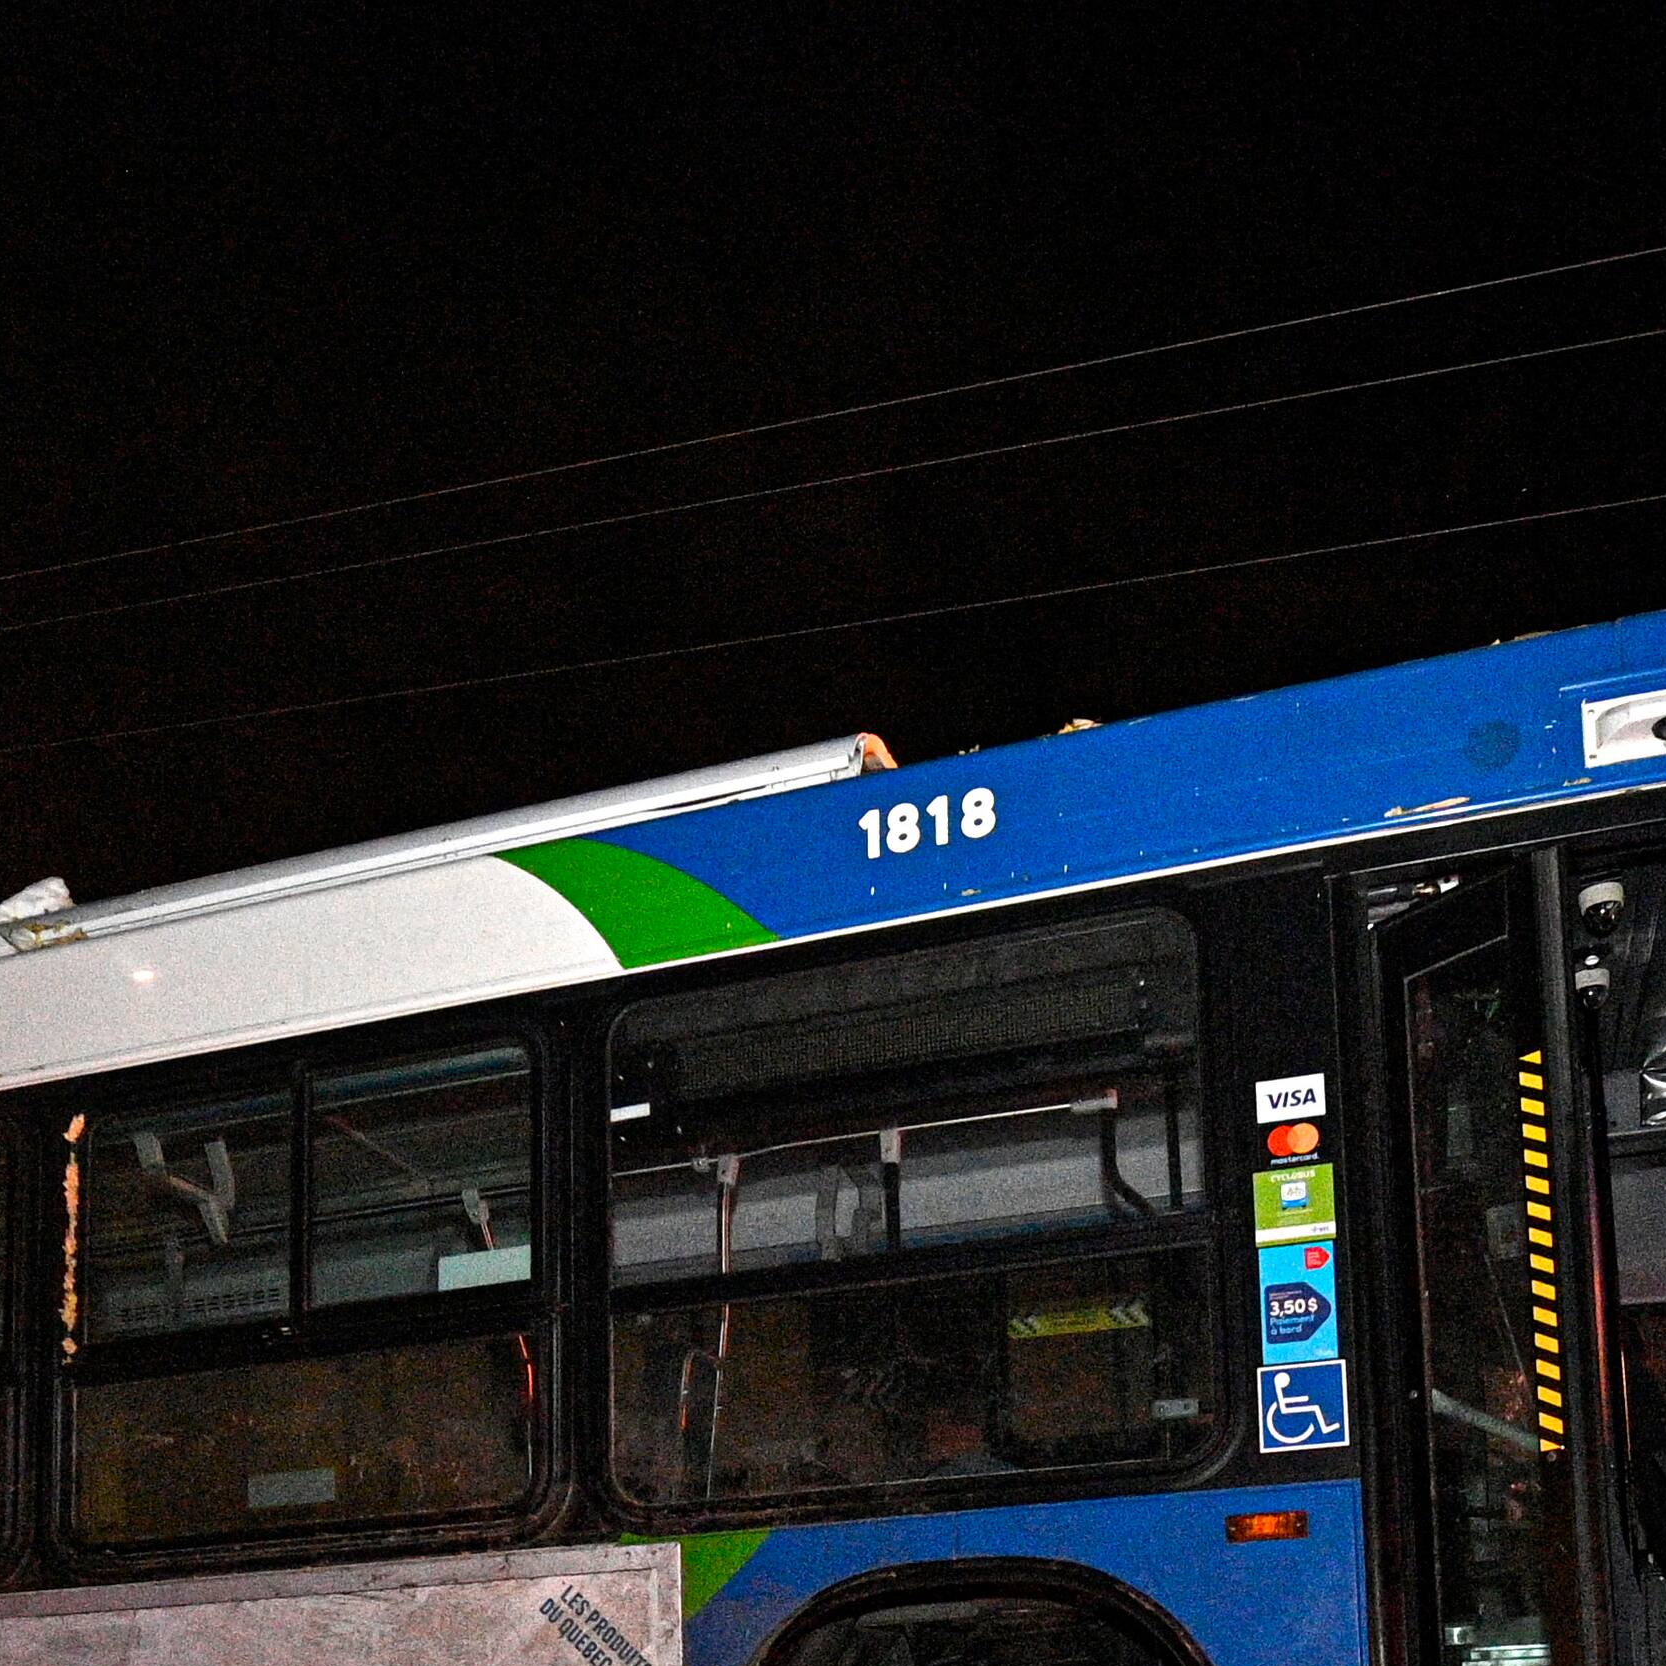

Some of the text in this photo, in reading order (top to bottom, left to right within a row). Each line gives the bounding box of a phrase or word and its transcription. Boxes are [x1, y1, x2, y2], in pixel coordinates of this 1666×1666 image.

[858, 787, 997, 860] 1818
[1266, 1088, 1317, 1110] VISA
[1270, 1169, 1316, 1183] CYCLOBUS
[1269, 1297, 1319, 1317] 3,50 $
[1279, 1323, 1303, 1335] bord
[539, 1598, 564, 1623] DU
[561, 1585, 590, 1616] LES
